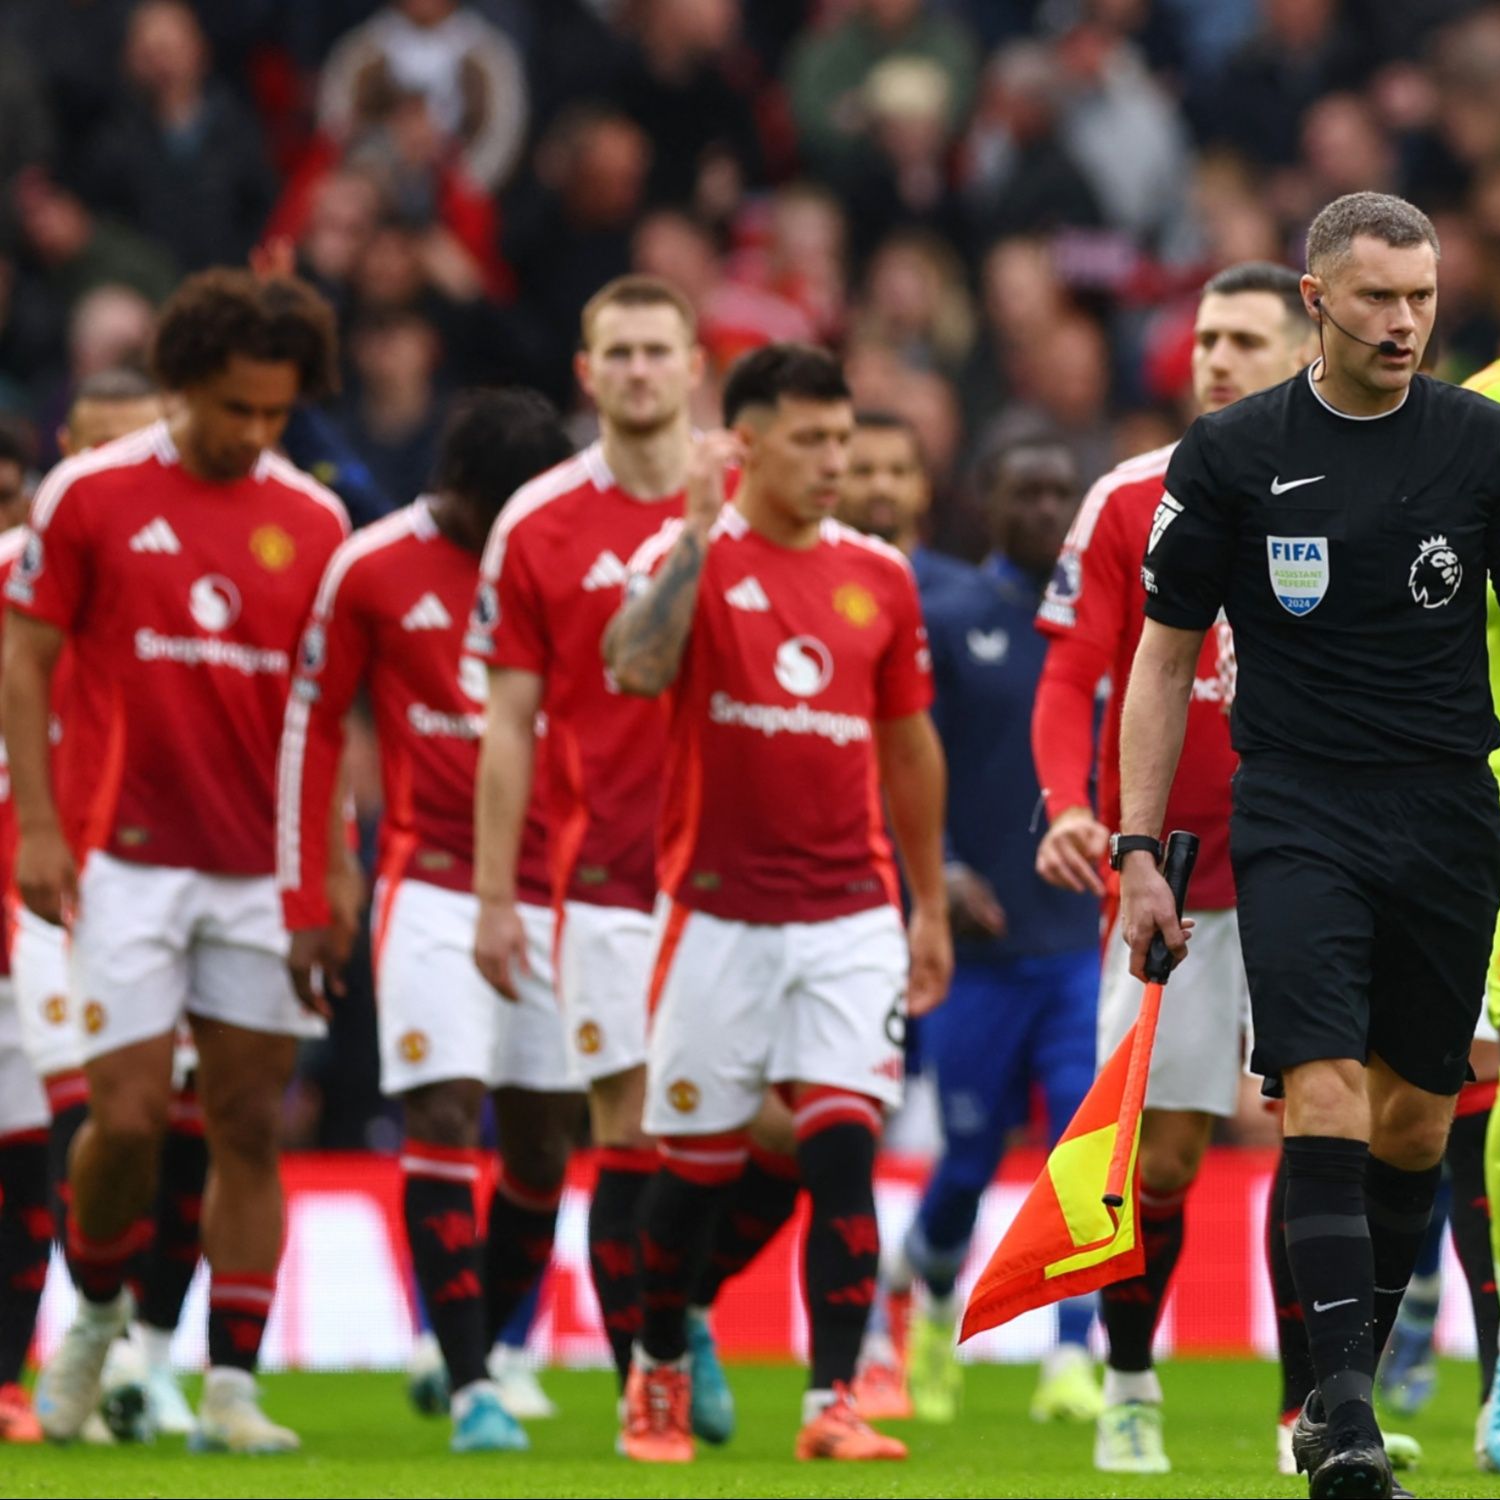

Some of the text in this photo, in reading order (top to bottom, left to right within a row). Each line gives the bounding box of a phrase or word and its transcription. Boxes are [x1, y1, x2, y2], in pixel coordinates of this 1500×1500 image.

[1271, 542, 1322, 561] FIFA
[1274, 569, 1322, 578] ASSISTANT
[1278, 578, 1318, 588] REFEREE
[1287, 599, 1311, 608] 2024
[710, 690, 872, 746] Snapdragon
